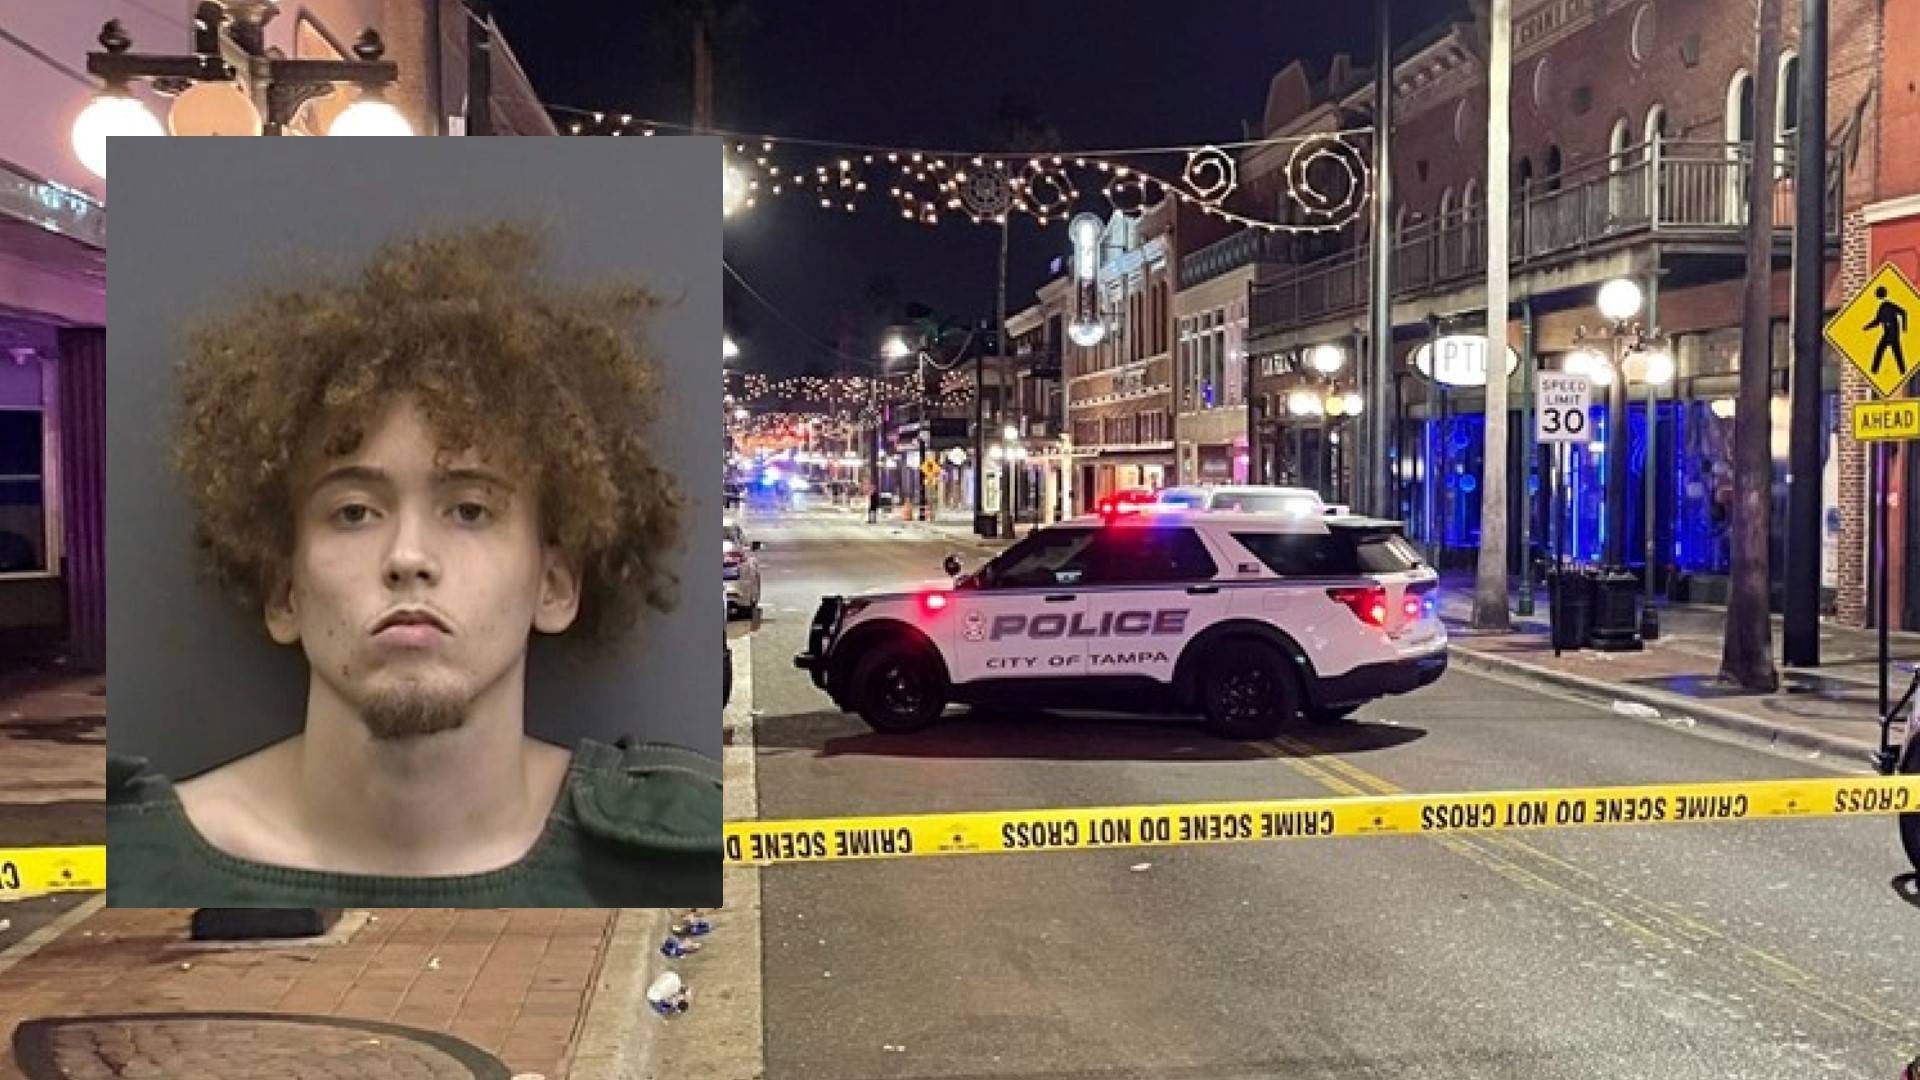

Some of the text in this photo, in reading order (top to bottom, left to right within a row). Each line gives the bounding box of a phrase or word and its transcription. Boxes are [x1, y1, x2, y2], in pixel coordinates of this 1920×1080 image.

[1542, 379, 1587, 392] SPEED
[1545, 394, 1581, 405] LIMIT
[1542, 407, 1584, 434] 30
[1861, 410, 1913, 430] AHEAD
[989, 608, 1190, 641] POLICE
[986, 651, 1169, 669] CITY OF TAMPA
[1421, 794, 1748, 831] CRIME SCENE DO NOT CROSS
[1835, 786, 1909, 813] CROSS
[1002, 810, 1335, 849] CRIME SCENE DO NOT CROSS
[726, 827, 913, 860] CRIME SCENE D
